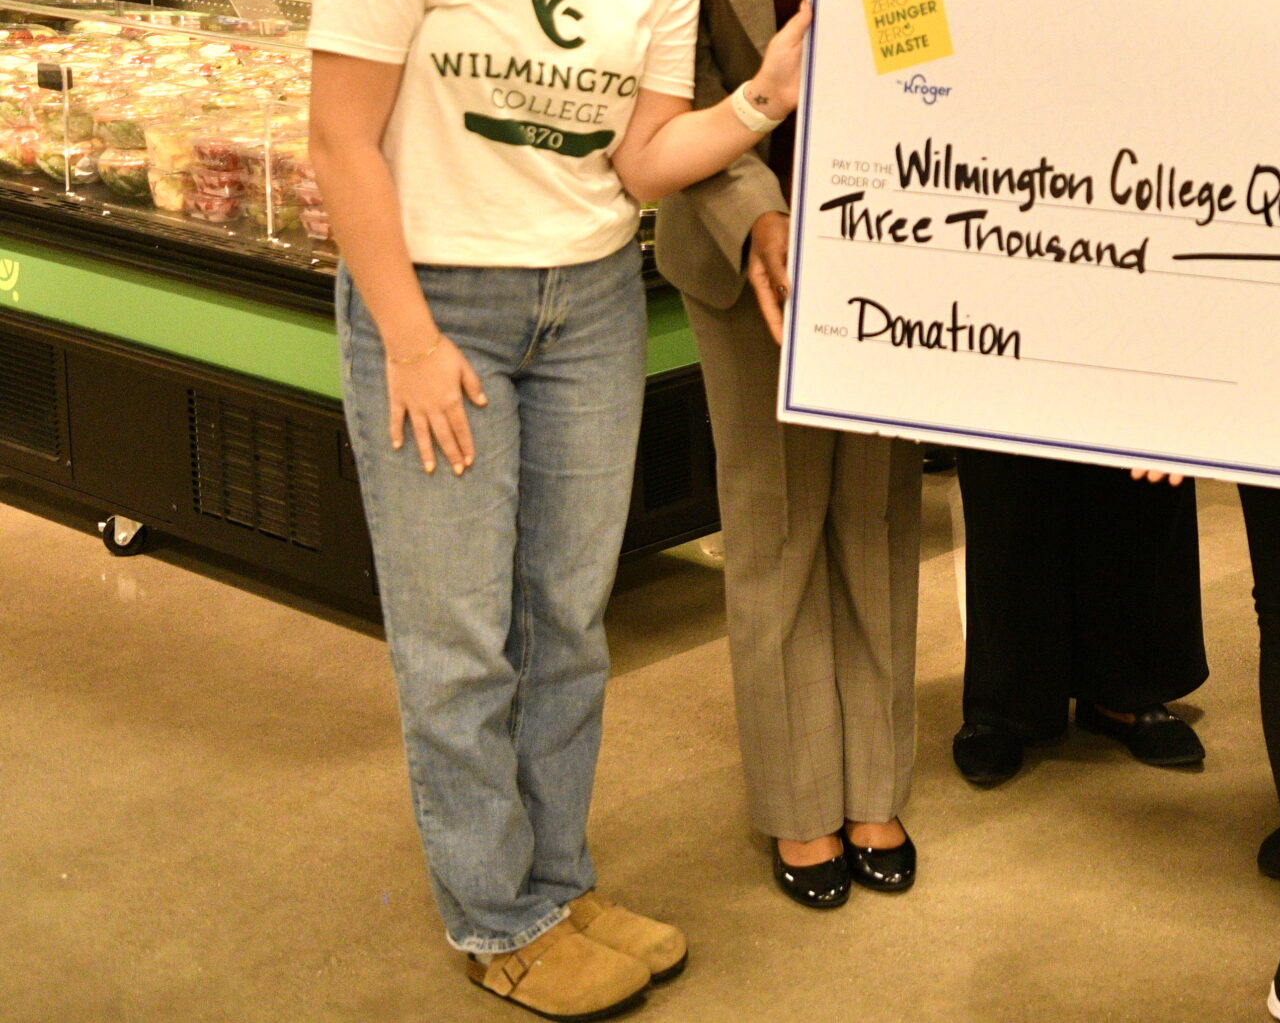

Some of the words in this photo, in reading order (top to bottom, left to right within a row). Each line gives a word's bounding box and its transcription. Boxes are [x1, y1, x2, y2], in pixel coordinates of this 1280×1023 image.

[874, 0, 938, 29] HUNGER
[878, 23, 915, 45] ZERO
[880, 34, 930, 59] WASTE
[903, 73, 953, 106] Kroger
[491, 88, 609, 125] COLLEGE
[831, 174, 870, 188] ORDER
[832, 158, 852, 171] PAY
[854, 160, 871, 173] TO
[873, 162, 896, 176] THE
[895, 137, 1094, 213] Wilmington
[1110, 148, 1237, 227] College
[819, 191, 934, 244] Three
[945, 208, 1149, 274] Thousand
[814, 323, 850, 338] MEMO
[847, 296, 1021, 360] Donation
